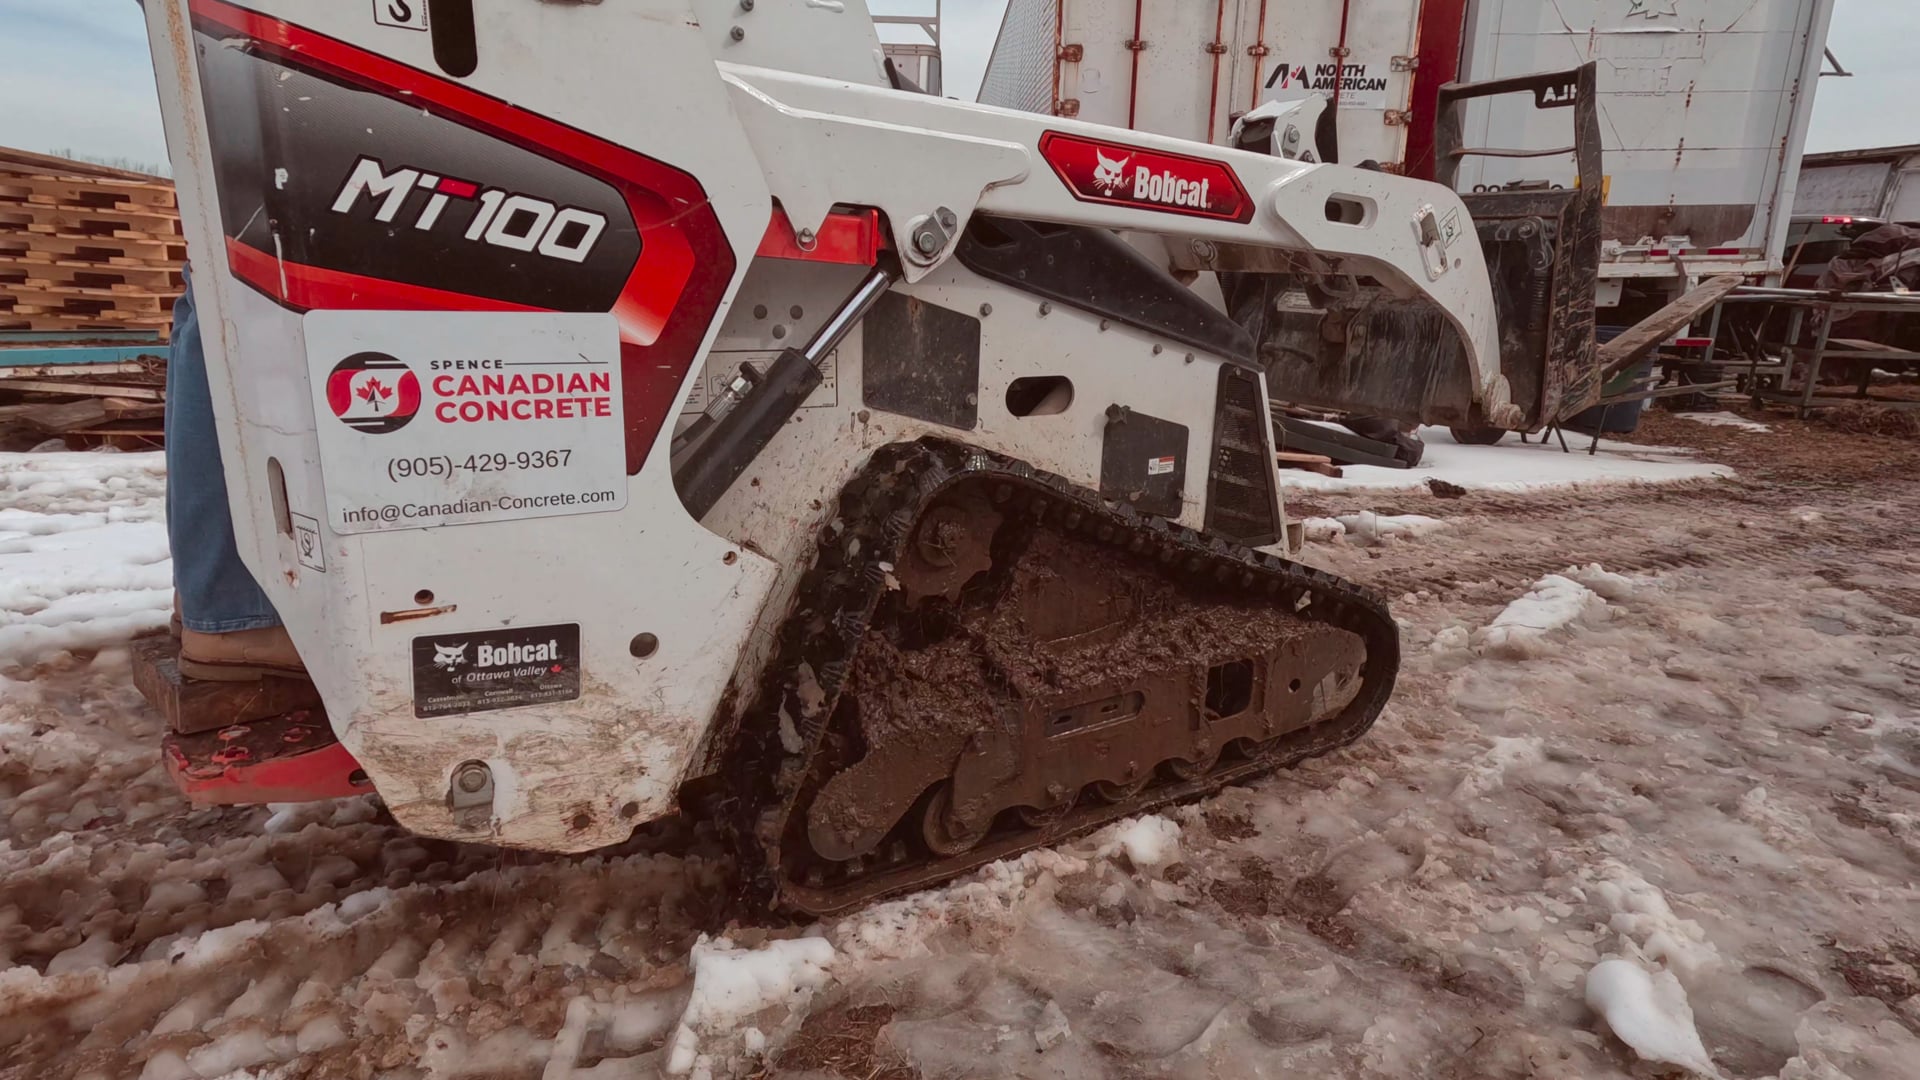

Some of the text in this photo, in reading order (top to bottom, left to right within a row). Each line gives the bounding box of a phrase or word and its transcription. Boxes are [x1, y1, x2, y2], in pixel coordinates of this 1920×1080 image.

[1134, 166, 1209, 208] Bobcat
[331, 158, 606, 263] MT100
[430, 359, 504, 370] SPENCE
[432, 372, 611, 397] CANADIAN
[434, 397, 612, 424] CONCRETE
[387, 449, 573, 483] (905)-429-9367
[342, 489, 616, 523] info@Canadian-Concrete.com
[477, 639, 558, 667] Bobcat
[451, 665, 548, 685] of Ottawa Valley
